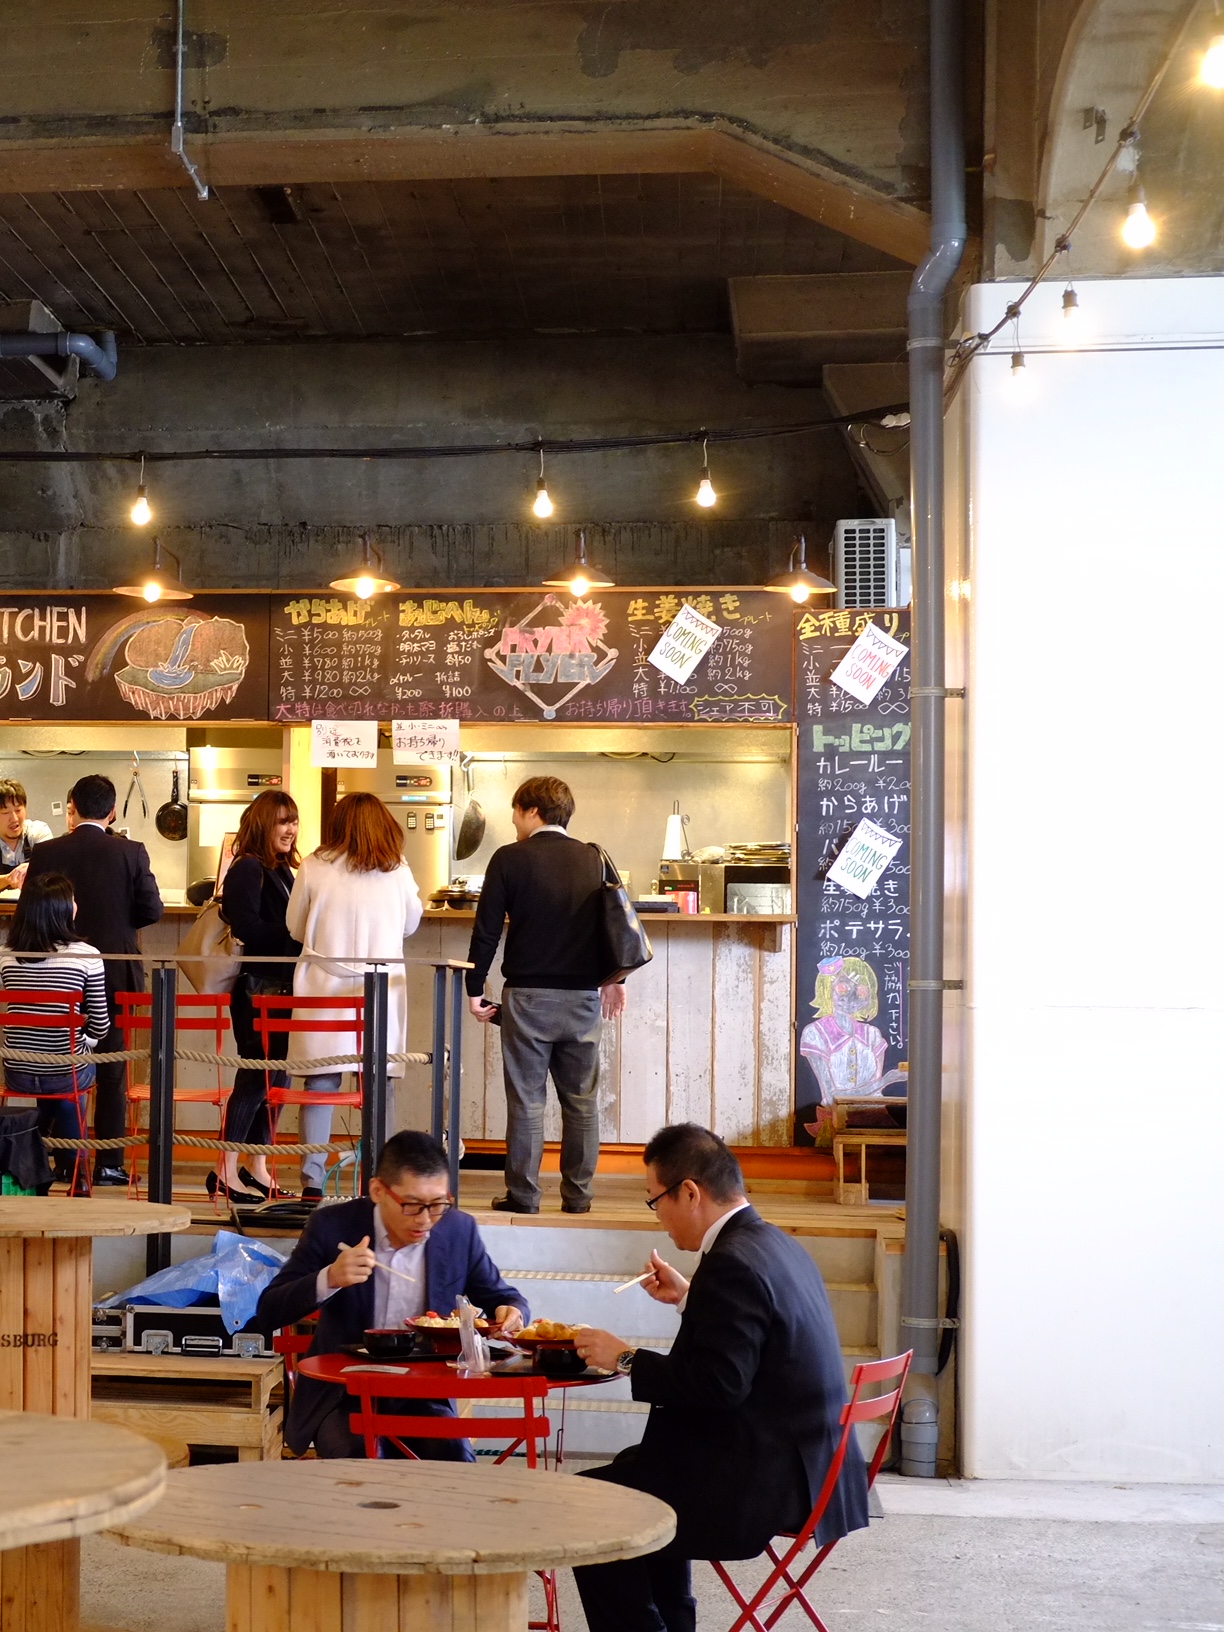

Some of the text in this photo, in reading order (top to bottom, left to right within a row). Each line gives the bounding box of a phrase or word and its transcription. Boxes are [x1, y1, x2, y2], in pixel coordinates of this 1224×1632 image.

[284, 598, 375, 626] からあげ
[274, 627, 298, 642] ミニ
[300, 626, 339, 644] ¥500
[628, 623, 654, 638] ミニ
[718, 626, 754, 639] 500g
[665, 621, 709, 656] COMING
[279, 644, 294, 655] 小
[302, 643, 337, 656] ¥600
[633, 638, 648, 651] 小
[800, 641, 824, 655] ミニ
[279, 656, 294, 669] 並
[302, 656, 338, 669] ¥780
[632, 653, 651, 667] 並
[659, 641, 693, 670] SOON
[802, 655, 821, 670] 小
[851, 644, 895, 680] COMING
[280, 670, 295, 684] 大
[301, 669, 340, 683] ¥980
[505, 652, 598, 684] FLYER
[633, 667, 650, 682] 大
[845, 662, 878, 691] SOON
[804, 669, 822, 686] 並
[279, 685, 296, 701] 特
[395, 684, 472, 701] ¥200 ¥100
[632, 682, 649, 699] 特
[805, 686, 822, 700] 大
[696, 700, 777, 717] シェア不可
[807, 702, 824, 718] 特
[812, 722, 912, 753] トッピング
[816, 753, 904, 775] カレールー
[820, 793, 908, 817] からあげ
[844, 837, 889, 871] COMING
[840, 856, 874, 884] SOON
